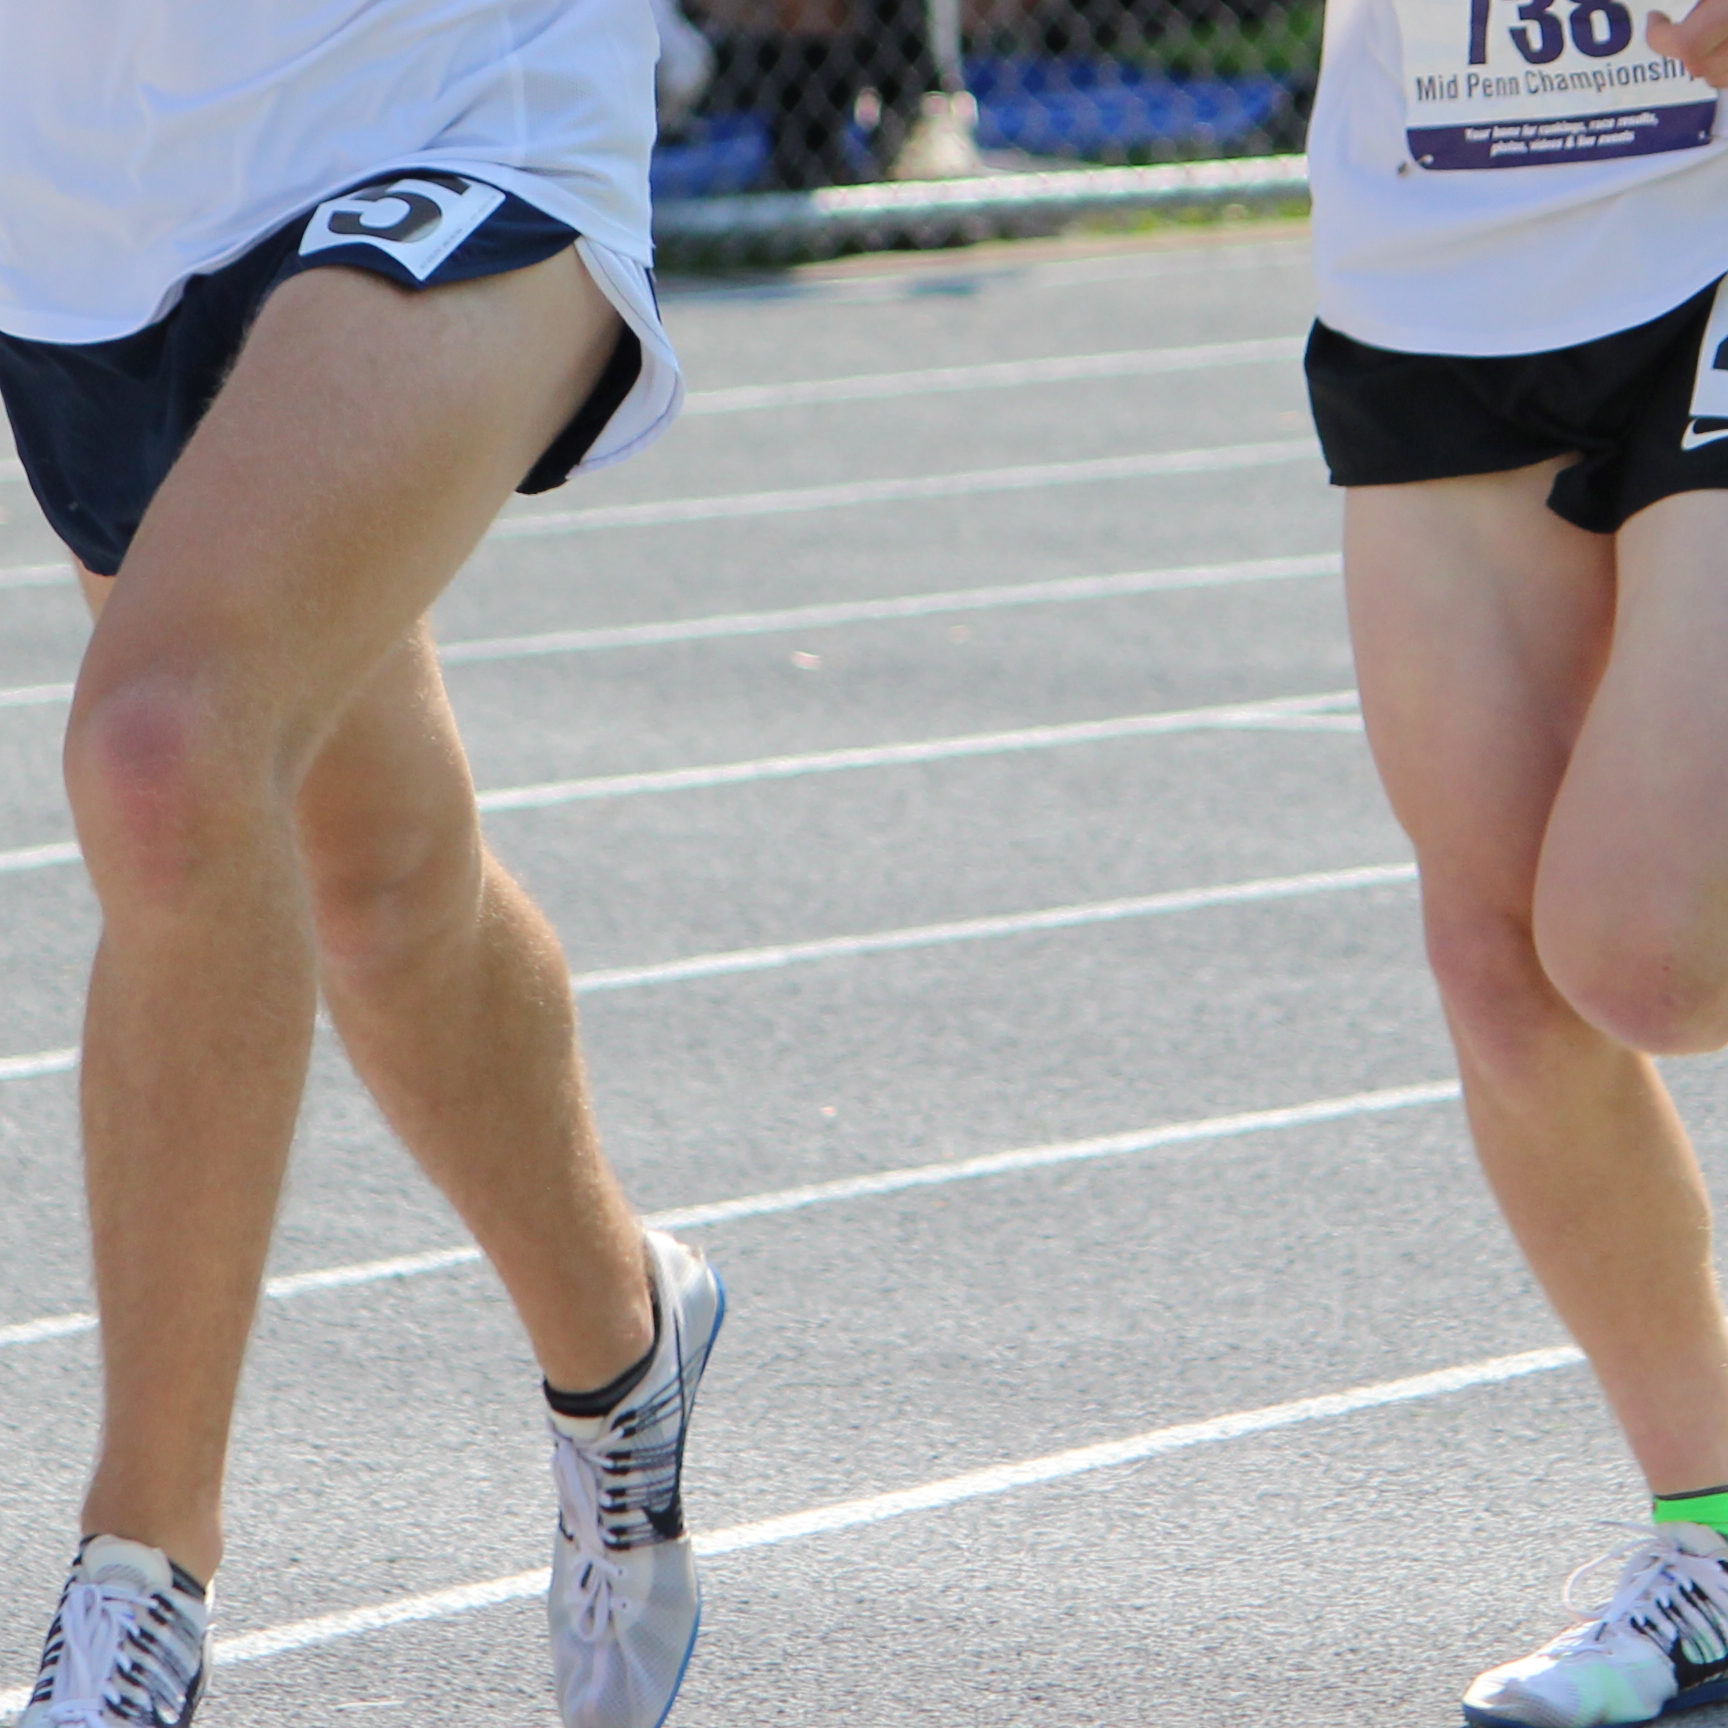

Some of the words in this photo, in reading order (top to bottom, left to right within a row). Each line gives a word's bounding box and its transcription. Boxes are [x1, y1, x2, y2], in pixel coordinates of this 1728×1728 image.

[1416, 73, 1459, 101] Mid
[1466, 72, 1520, 99] Penn
[1525, 56, 1694, 94] Championshi
[327, 176, 471, 243] 5
